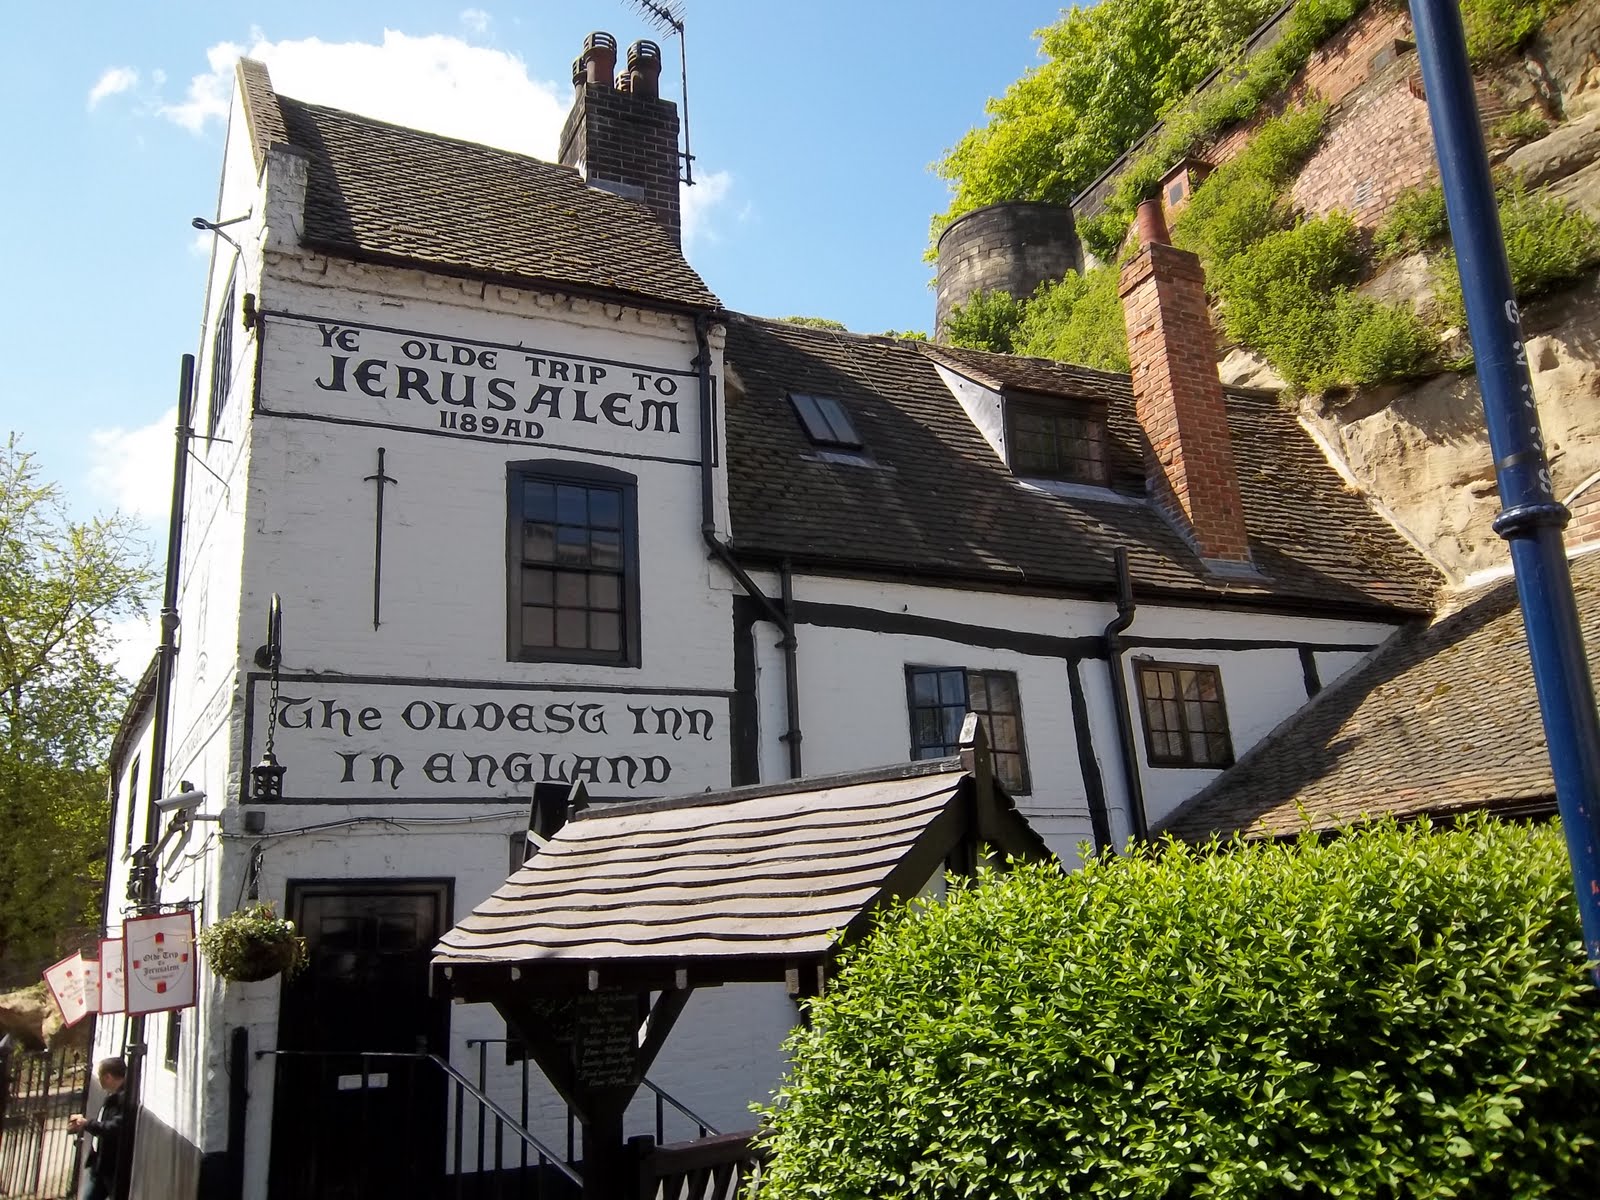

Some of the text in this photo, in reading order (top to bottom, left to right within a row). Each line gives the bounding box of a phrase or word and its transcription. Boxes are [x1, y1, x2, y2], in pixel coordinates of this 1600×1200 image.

[316, 323, 678, 397] YE OLDE TRIP TO
[314, 354, 681, 435] JERUSALEM
[276, 695, 383, 738] The
[400, 700, 608, 735] OLDEST
[421, 751, 673, 791] ENGLAND
[142, 951, 179, 962] Olde Trip
[143, 965, 180, 976] Jerusalem
